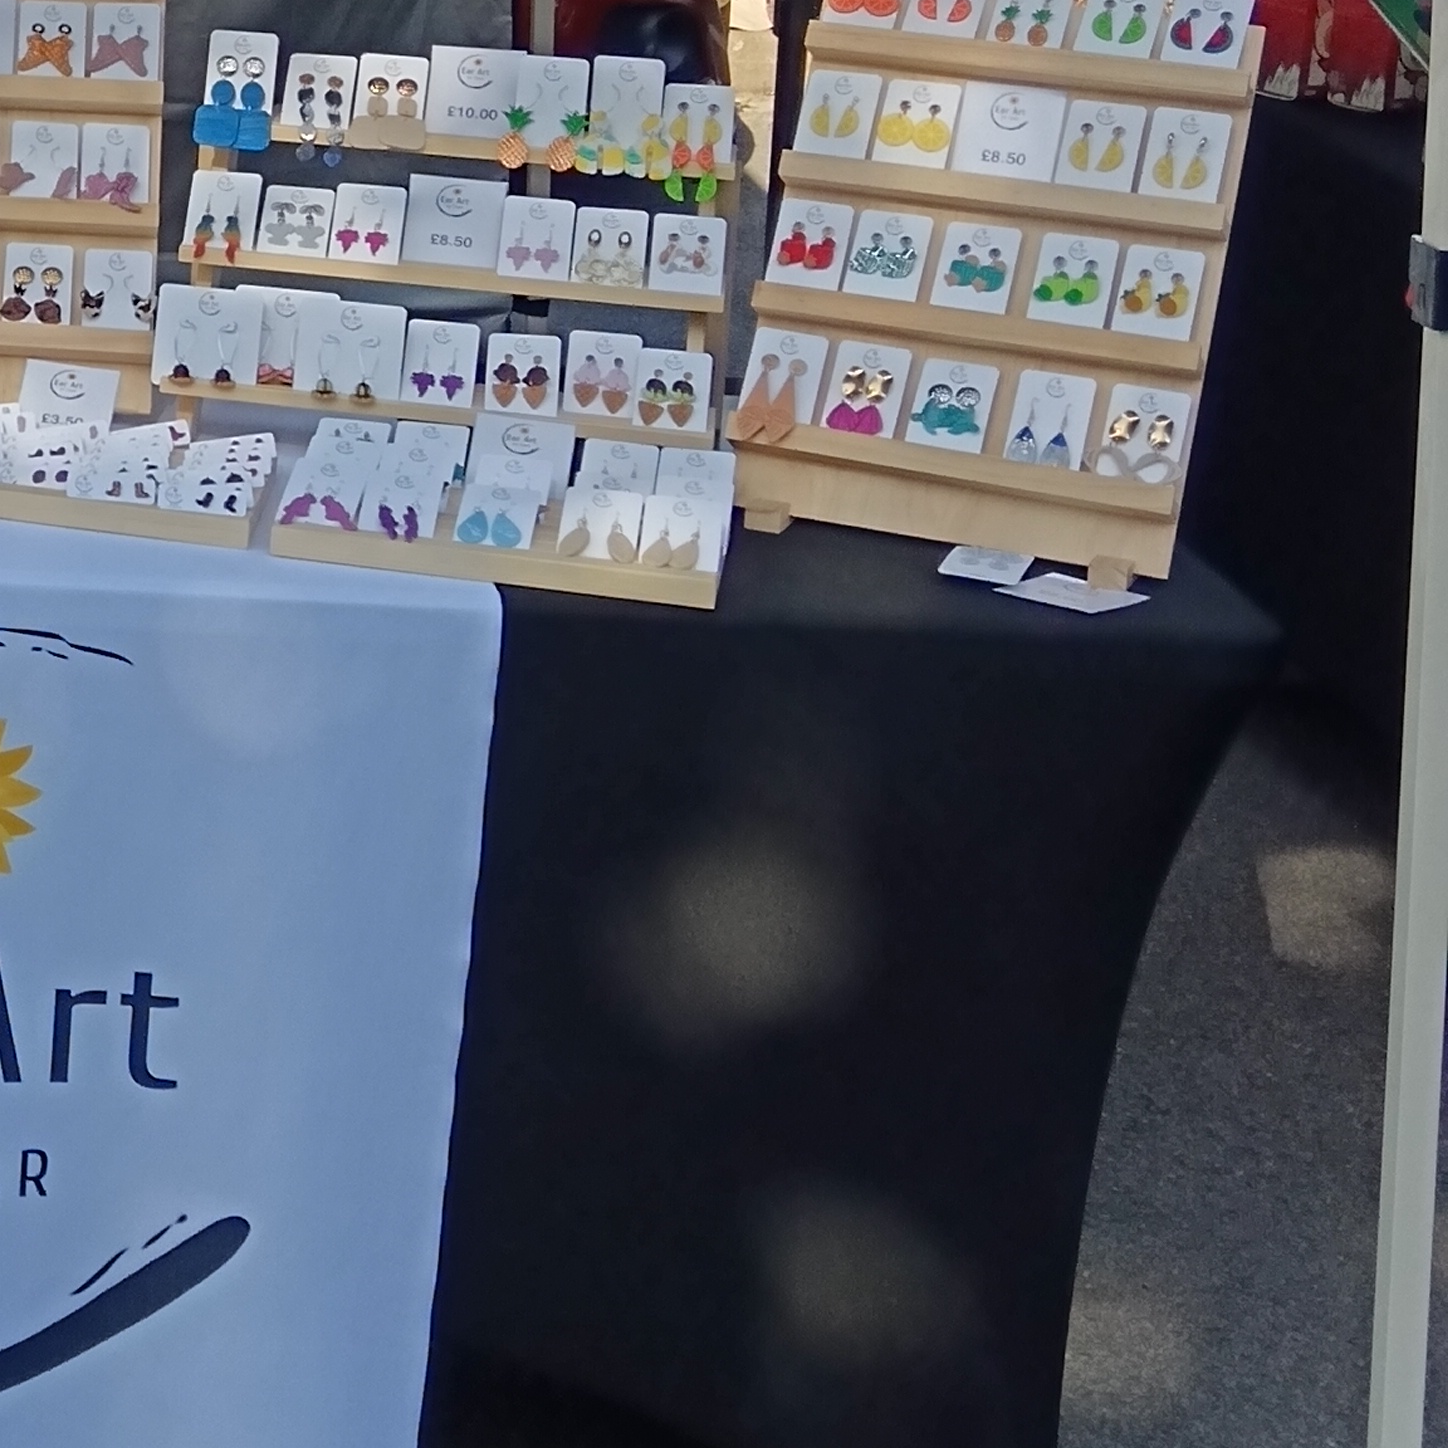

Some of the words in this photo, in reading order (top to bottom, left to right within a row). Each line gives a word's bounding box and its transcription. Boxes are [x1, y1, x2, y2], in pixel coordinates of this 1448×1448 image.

[448, 105, 498, 121] £10.00
[981, 149, 1026, 166] £8.50
[430, 234, 472, 248] £8.50
